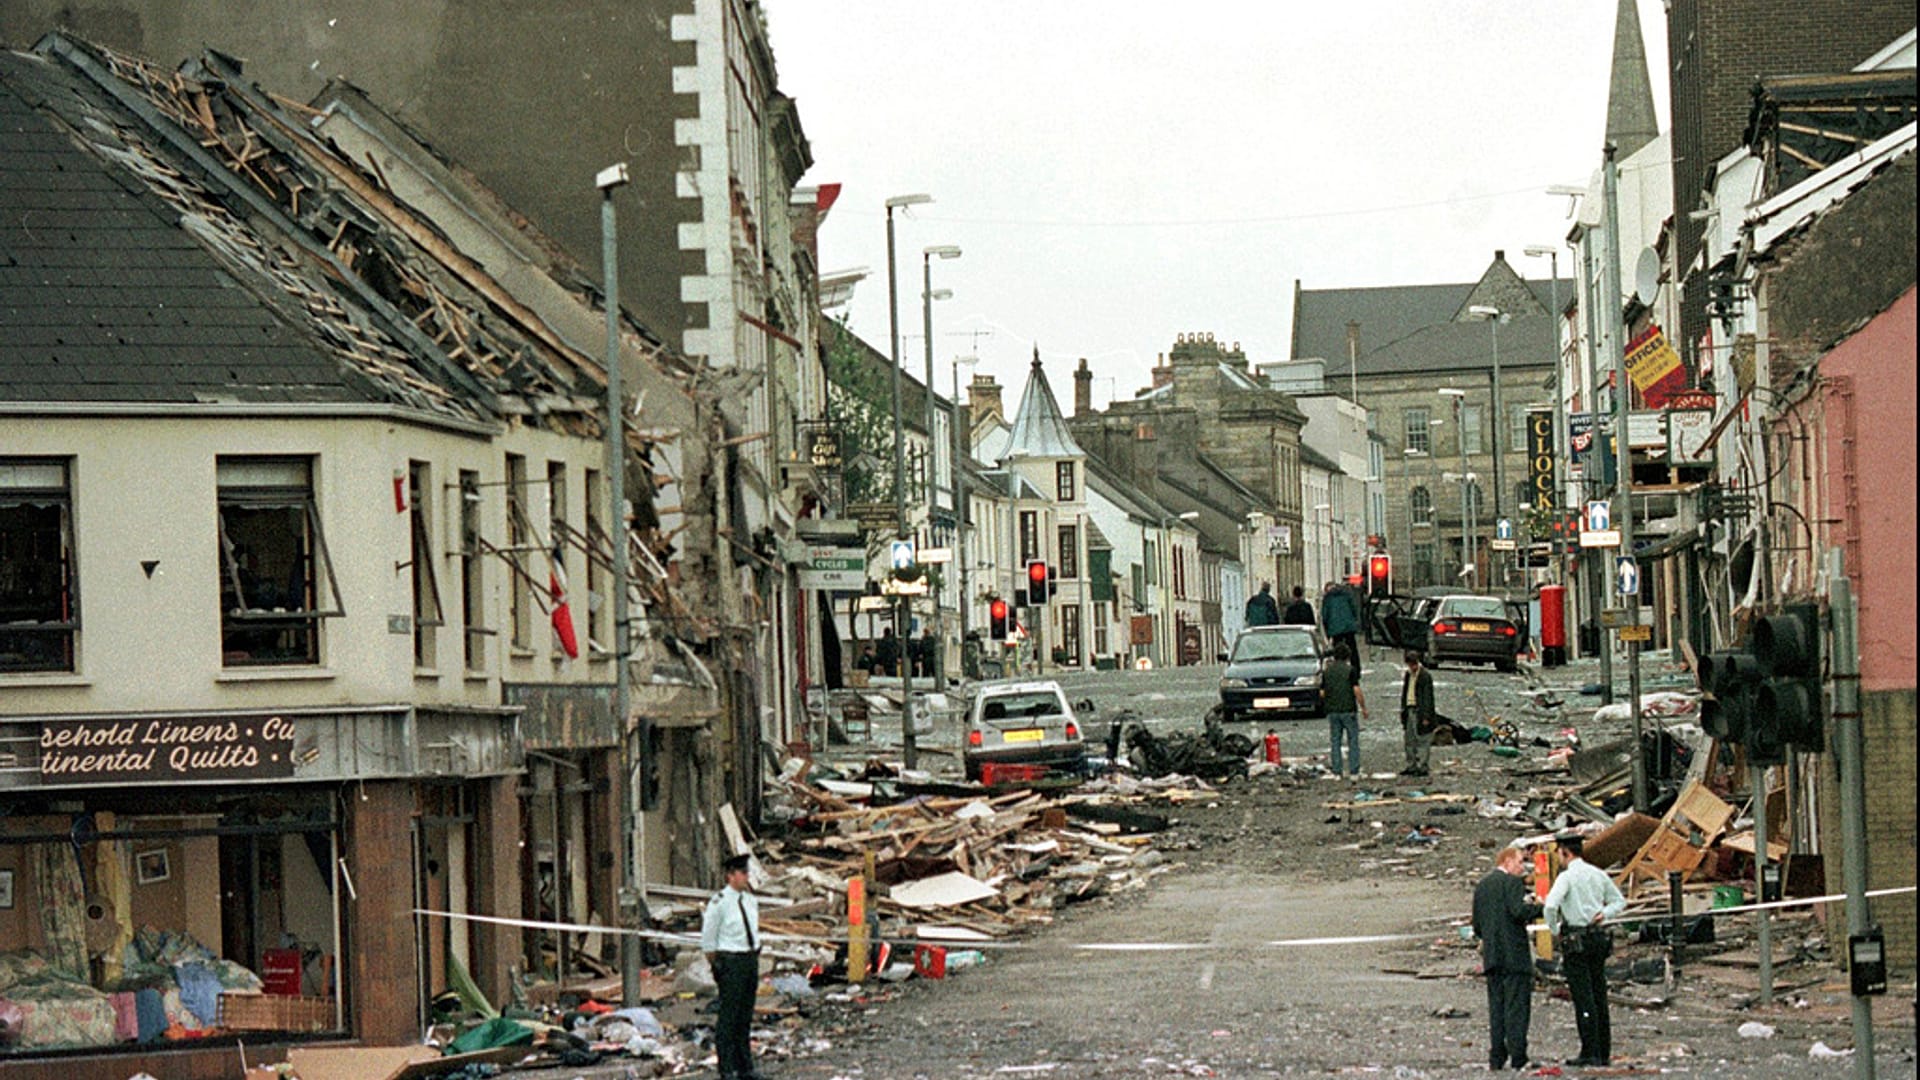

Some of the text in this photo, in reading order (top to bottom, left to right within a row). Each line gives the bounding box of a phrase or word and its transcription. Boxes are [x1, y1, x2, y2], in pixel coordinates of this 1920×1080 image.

[1624, 337, 1664, 369] OFFICES
[1535, 420, 1553, 510] CLOCK
[815, 560, 848, 569] CYCLES
[41, 723, 138, 747] sehold
[141, 721, 239, 743] Linens
[41, 747, 156, 774] tinental
[169, 745, 259, 772] Quilts
